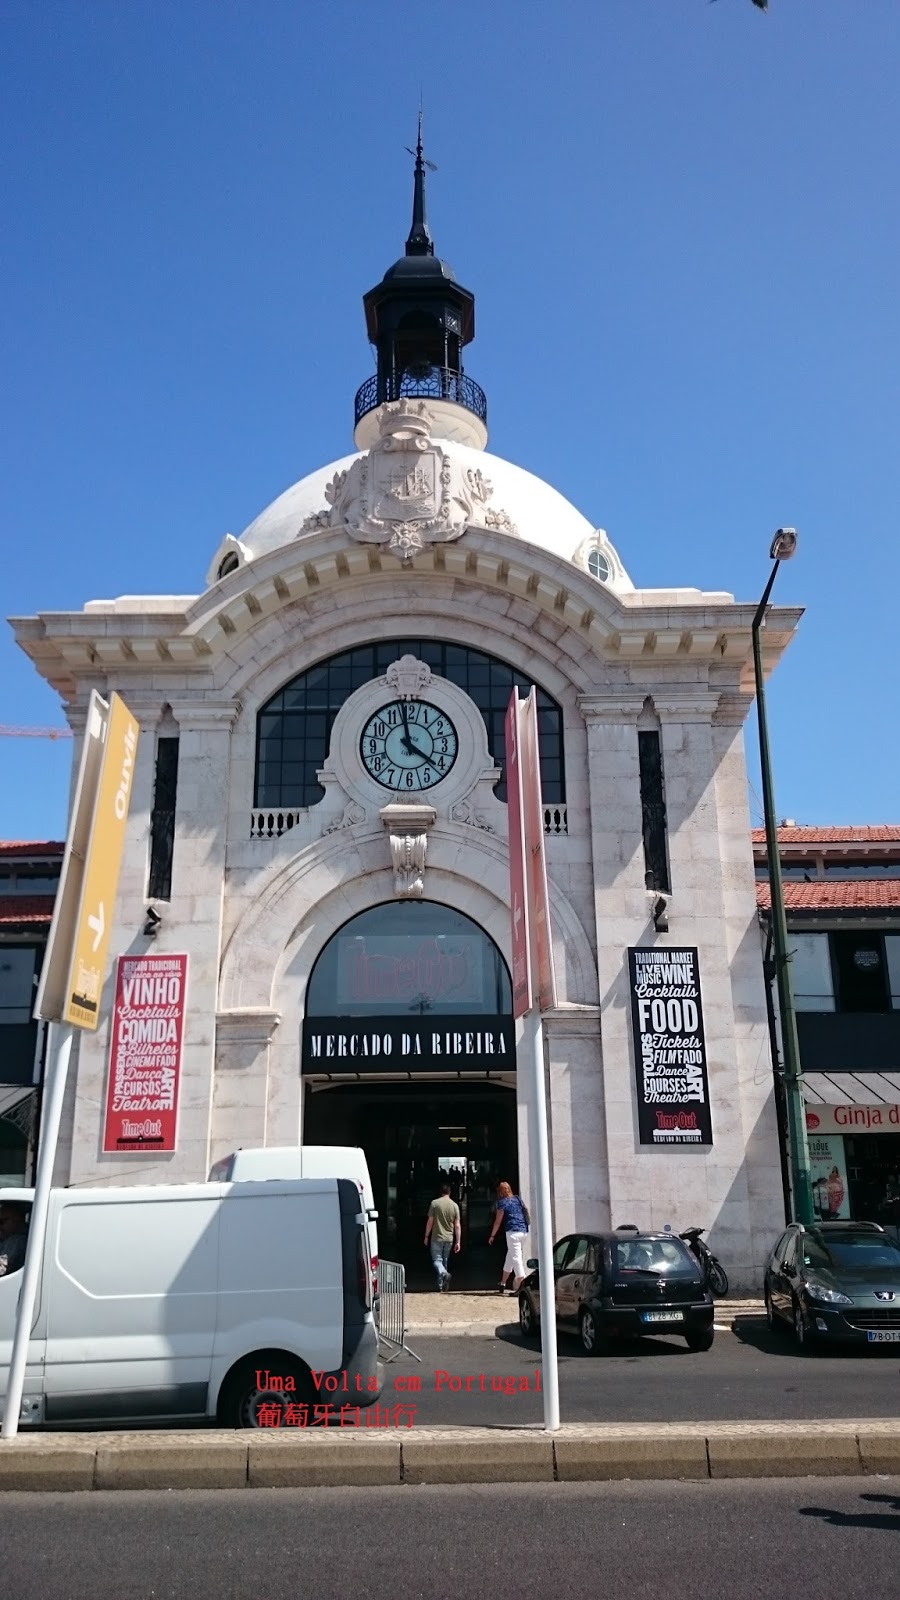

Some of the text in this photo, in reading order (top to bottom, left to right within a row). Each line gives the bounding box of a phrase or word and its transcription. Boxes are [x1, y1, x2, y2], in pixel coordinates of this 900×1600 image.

[388, 710, 396, 724] 11
[424, 709, 428, 724] 1
[373, 722, 385, 736] 10
[437, 720, 444, 735] 2
[370, 739, 376, 754] 9
[442, 738, 448, 752] 3
[374, 757, 381, 771] 8
[437, 756, 446, 770] 4
[387, 769, 395, 784] 7
[406, 772, 413, 787] 6
[424, 768, 430, 782] 5
[634, 952, 694, 964] TRADITIONAL MARKET
[636, 964, 660, 974] LIVE
[660, 964, 696, 984] WINE
[636, 972, 662, 984] MUSIC
[122, 977, 180, 1006] VINHO
[634, 984, 699, 998] Cocktails
[118, 1004, 182, 1020] Cocktails
[638, 998, 698, 1032] FOOD
[118, 1018, 178, 1044] COMIDA
[310, 1032, 507, 1058] MERCADO DA RIBEIRA
[652, 1033, 702, 1049] Tickets
[125, 1042, 178, 1056] Bilhetes
[640, 1033, 656, 1079] TOURS
[126, 1054, 176, 1068] CINEMA FADO
[654, 1050, 702, 1064] FILM FADO
[124, 1068, 162, 1081] Dança
[655, 1064, 688, 1076] Dance
[124, 1080, 162, 1096] CURSOS
[160, 1066, 176, 1110] ARTE
[644, 1078, 687, 1093] COURSES
[686, 1064, 705, 1104] ART
[112, 1095, 161, 1112] Teatro
[644, 1090, 690, 1104] Theatre
[834, 1106, 882, 1128] Ginja
